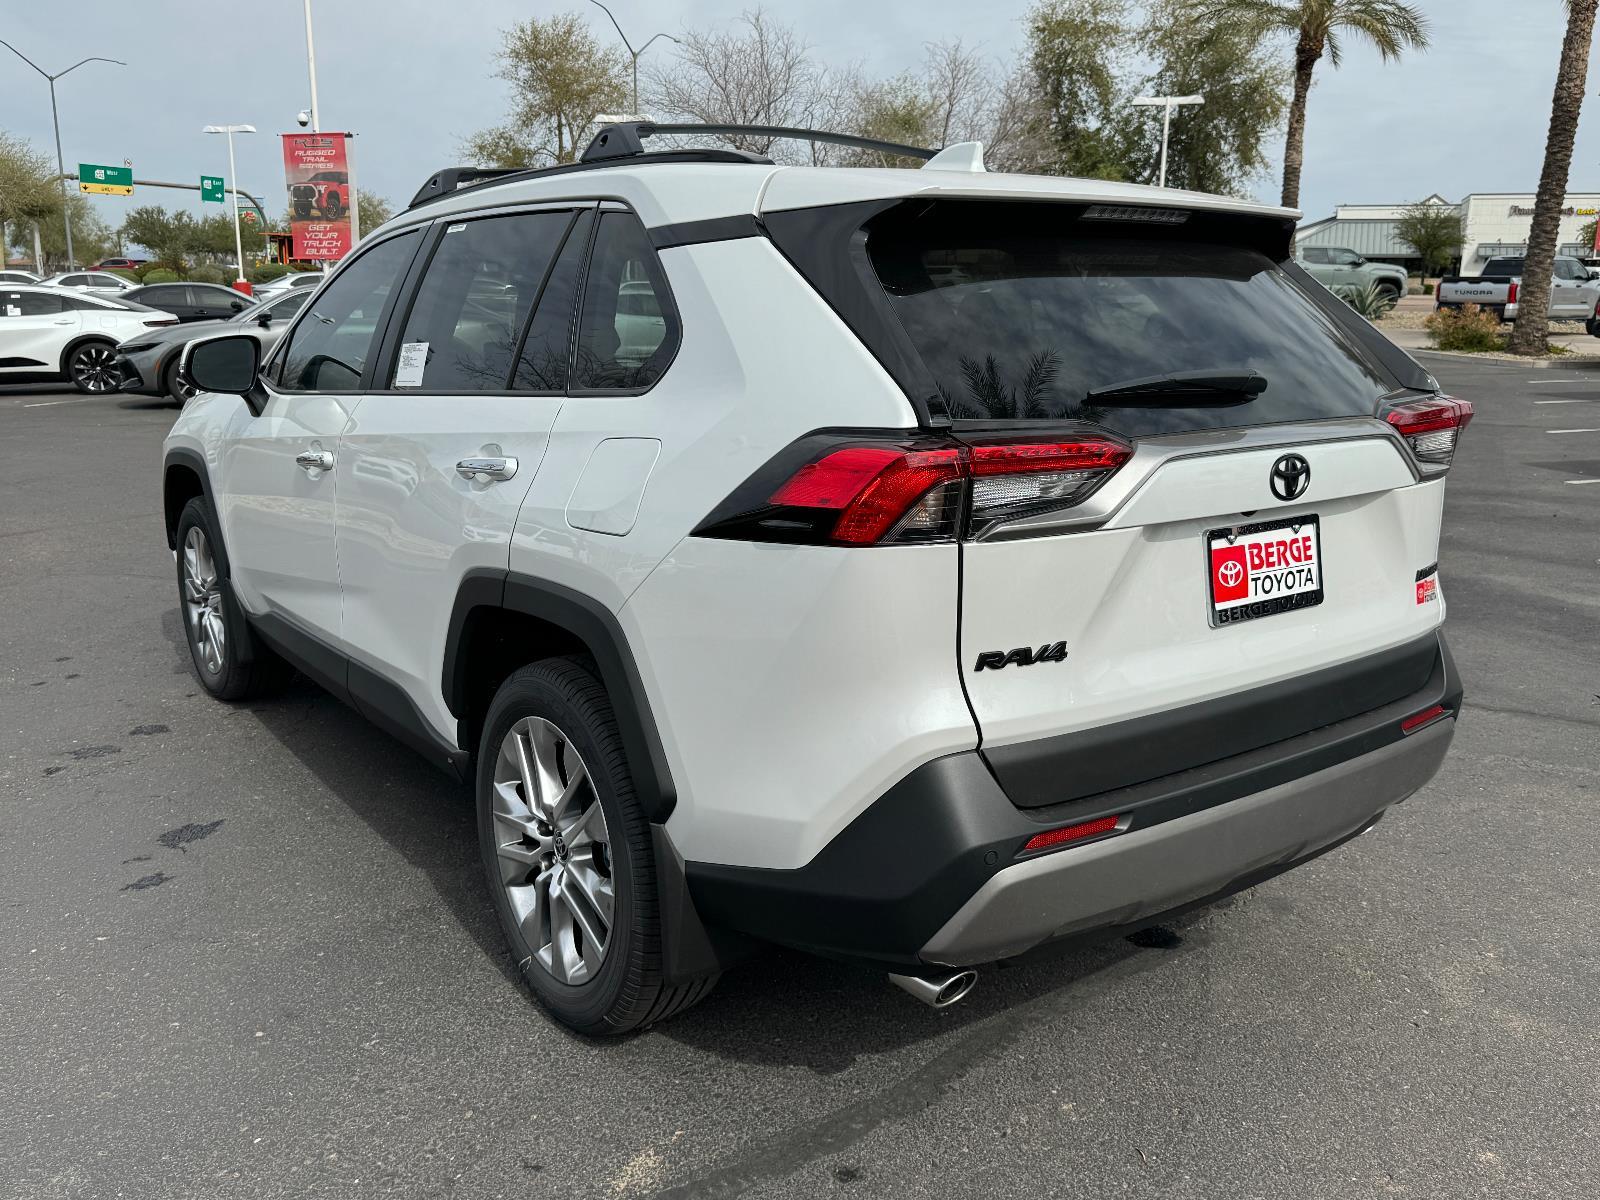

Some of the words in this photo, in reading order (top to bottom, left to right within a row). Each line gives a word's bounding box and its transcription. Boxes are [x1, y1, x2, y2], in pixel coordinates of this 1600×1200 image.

[1247, 536, 1313, 571] BERGE
[1251, 567, 1315, 596] TOYOTA
[1218, 602, 1271, 624] BERGE
[1275, 592, 1319, 610] TOYOTA
[974, 640, 1068, 672] RAV4
